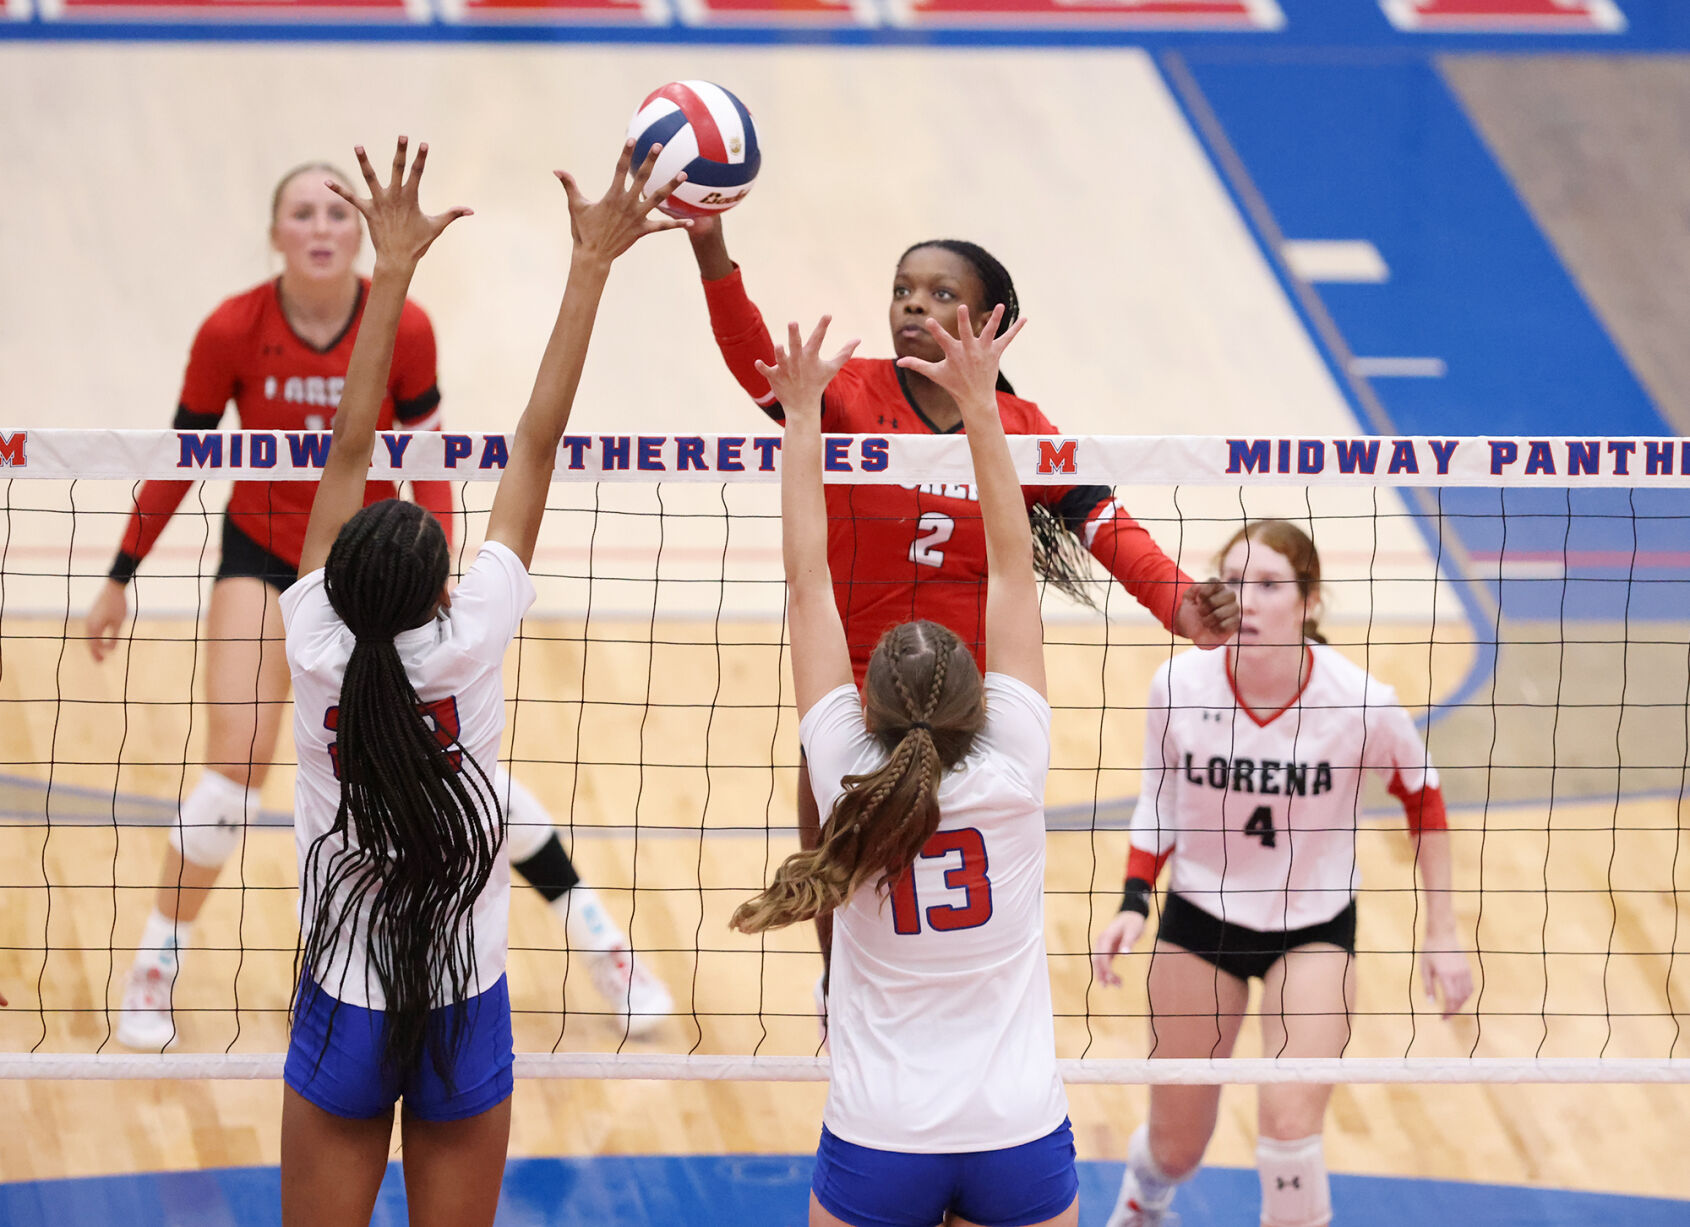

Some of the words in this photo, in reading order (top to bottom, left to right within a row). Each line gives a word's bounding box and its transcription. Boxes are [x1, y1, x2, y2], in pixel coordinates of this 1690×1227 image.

[177, 433, 413, 469] MIDWY
[441, 434, 889, 472] PATHERETES
[1036, 439, 1078, 475] M
[1226, 439, 1459, 476] MIDWAY
[907, 511, 955, 568] 2
[1185, 752, 1332, 797] LORENA
[1243, 805, 1276, 848] 4
